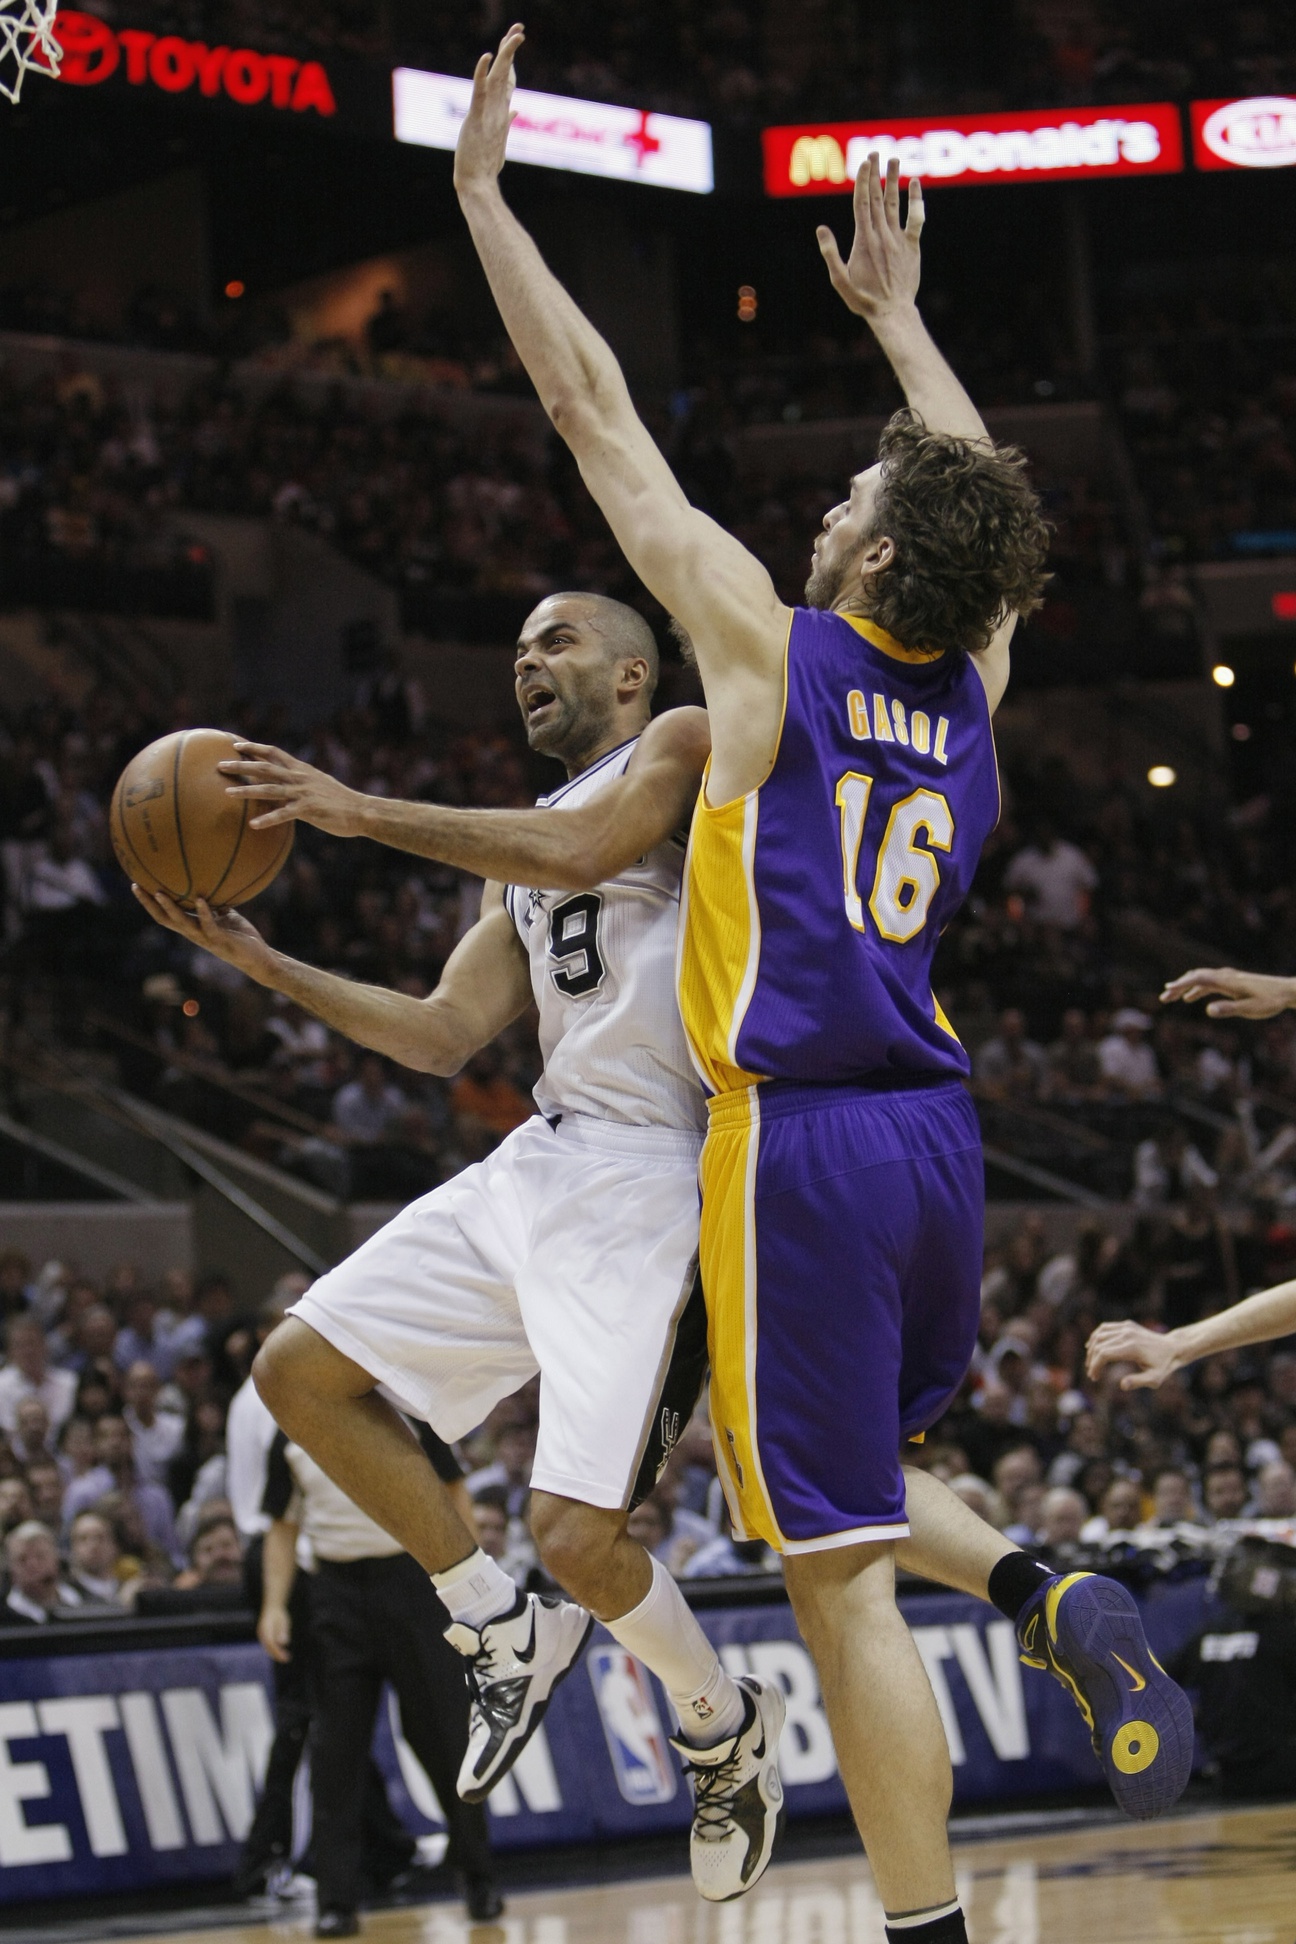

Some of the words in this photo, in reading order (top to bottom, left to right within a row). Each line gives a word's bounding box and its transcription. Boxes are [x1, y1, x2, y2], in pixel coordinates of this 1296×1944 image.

[117, 28, 337, 118] TOYOTA
[846, 120, 1162, 182] McDonald's
[847, 689, 950, 766] GASOL
[834, 770, 956, 944] 16
[547, 892, 606, 1000] 9
[0, 1682, 277, 1868] ETIM
